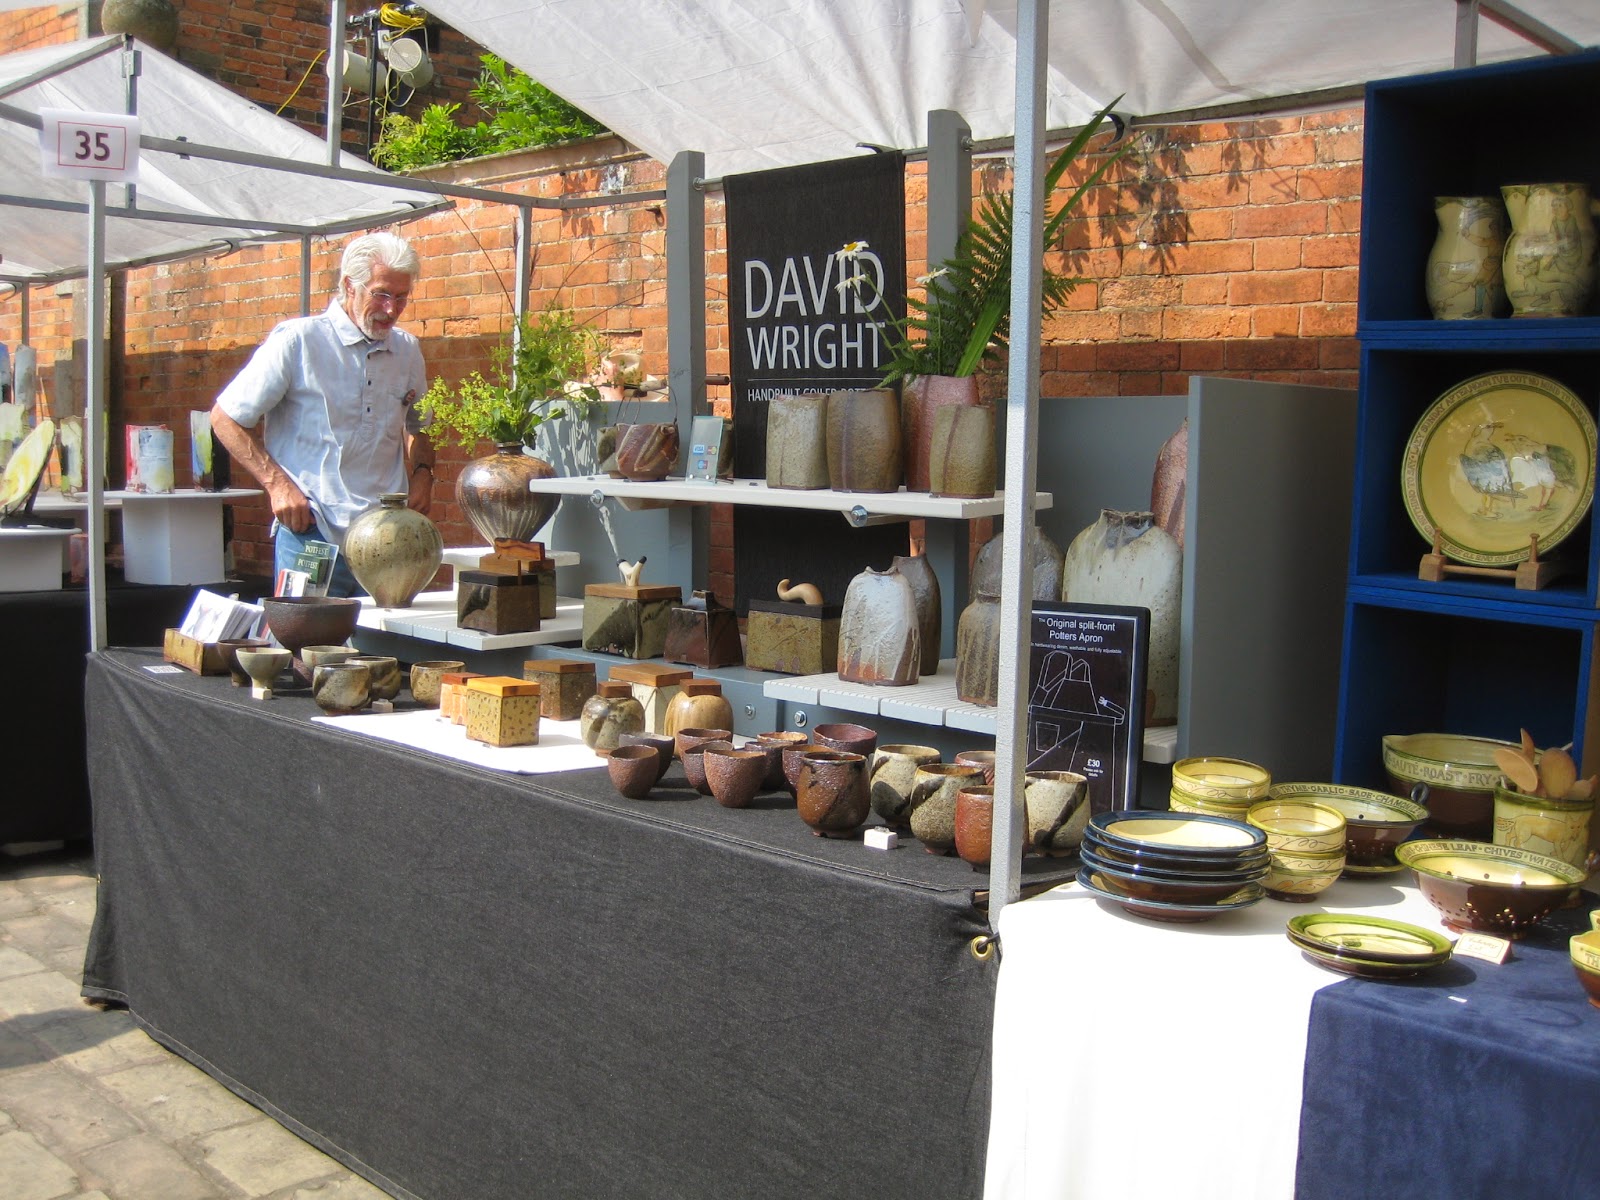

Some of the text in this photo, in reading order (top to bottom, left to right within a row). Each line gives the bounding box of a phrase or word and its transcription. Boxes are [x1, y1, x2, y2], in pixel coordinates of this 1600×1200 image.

[75, 131, 110, 161] 35
[744, 252, 885, 319] DAVID
[747, 322, 886, 370] WRIGHT
[305, 545, 328, 555] POTFEST
[298, 559, 318, 569] POTFEST
[1046, 618, 1076, 629] Original
[1078, 620, 1115, 631] split-front
[1049, 630, 1103, 643] Potters Apron
[1087, 758, 1100, 768] £30
[1423, 767, 1462, 781] ROAST
[1468, 773, 1492, 786] FRY
[1279, 784, 1308, 795] THYME
[1310, 786, 1344, 794] GARLIC
[1349, 789, 1372, 798] SAGE
[1450, 843, 1477, 852] LEAF
[1484, 846, 1522, 859] CHIVES
